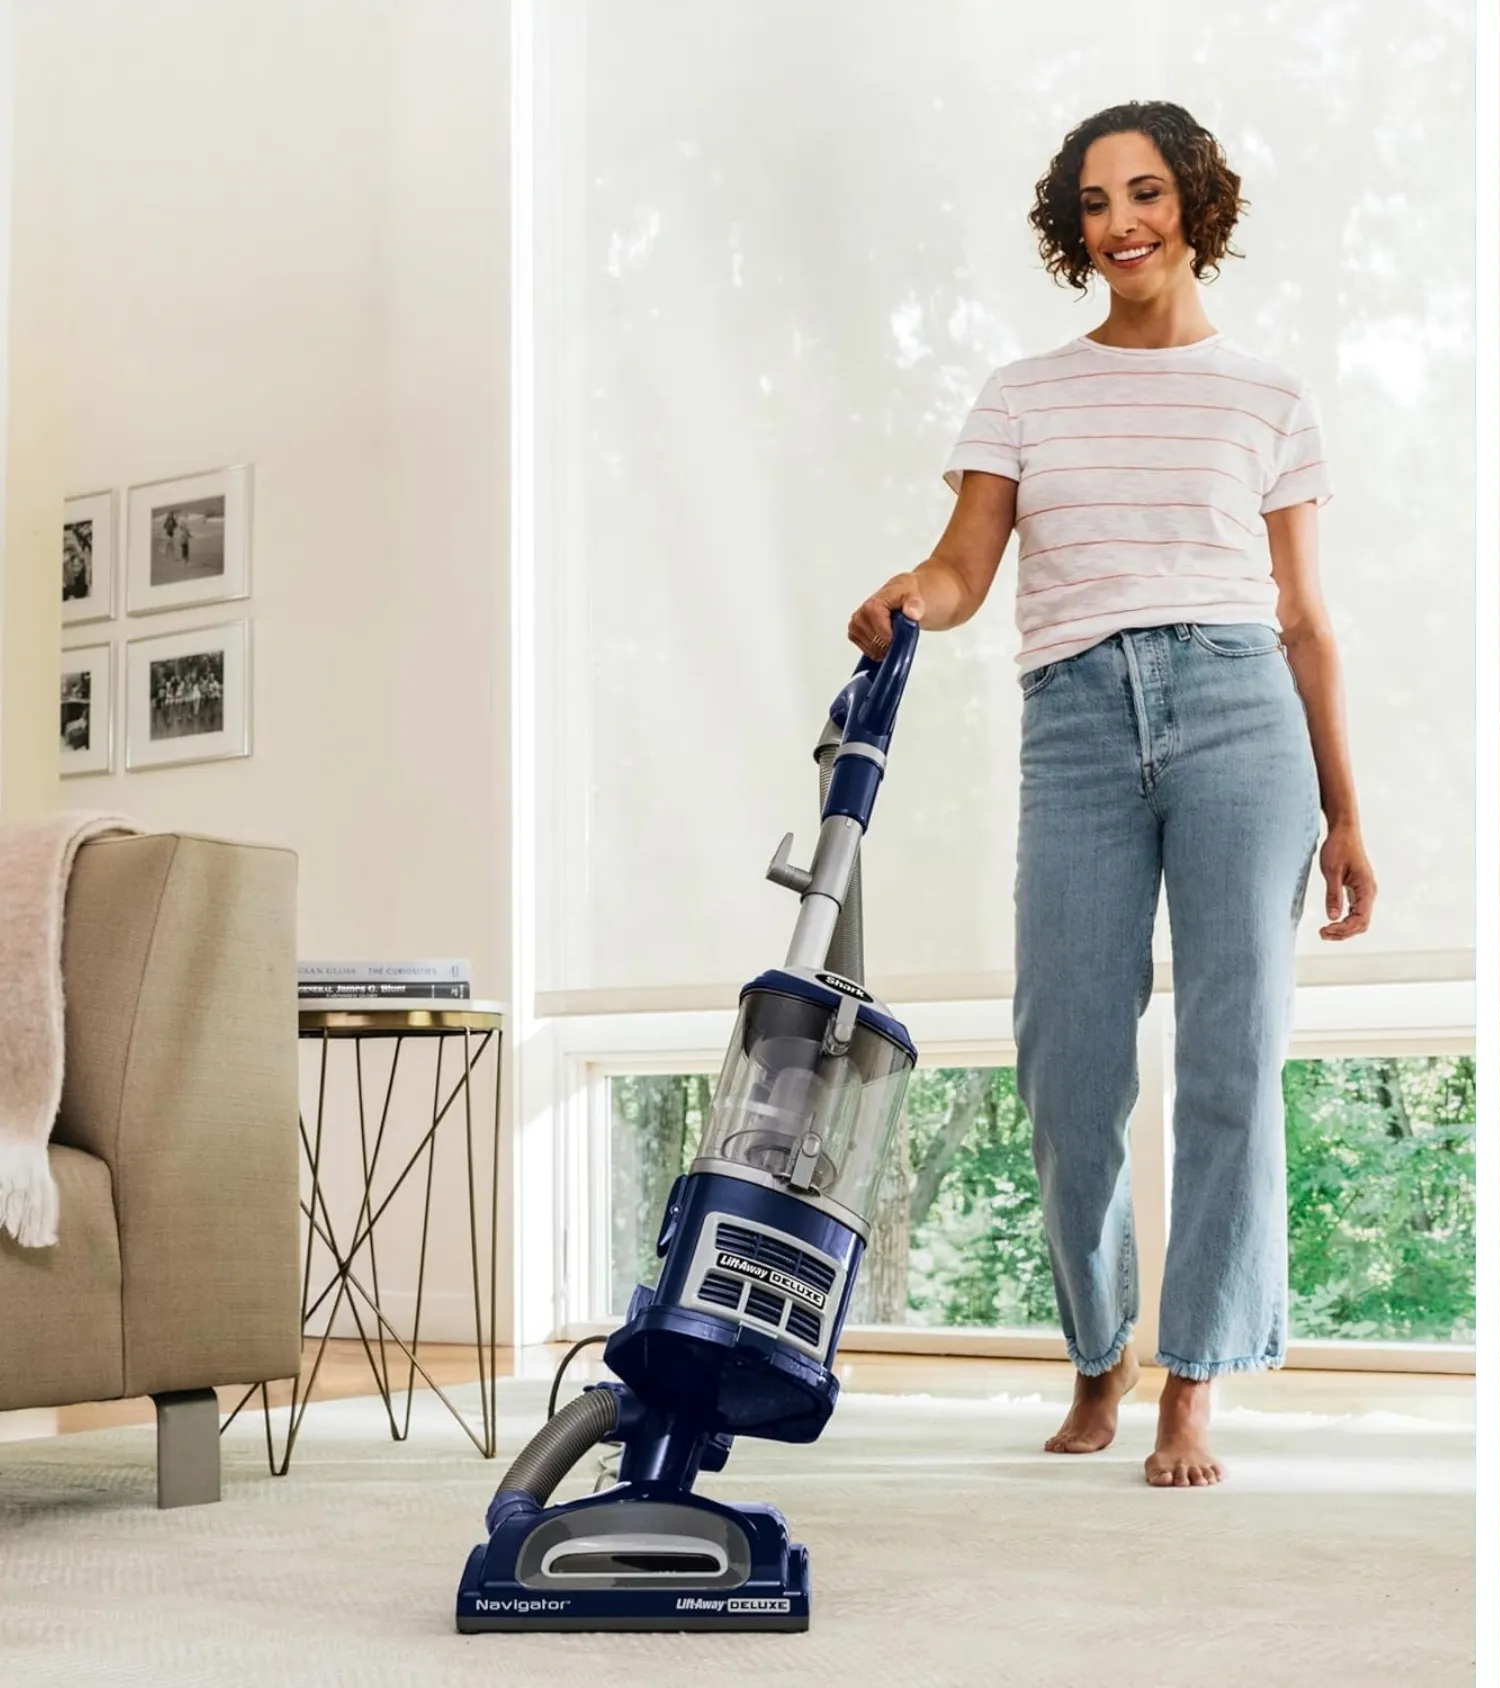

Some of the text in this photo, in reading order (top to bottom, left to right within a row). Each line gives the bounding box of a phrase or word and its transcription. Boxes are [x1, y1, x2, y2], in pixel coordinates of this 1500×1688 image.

[368, 967, 384, 975] THE
[825, 975, 866, 998] Shark
[719, 1254, 822, 1303] Lift-Away DELUXE
[675, 1597, 789, 1612] Lift-Away DELUXE
